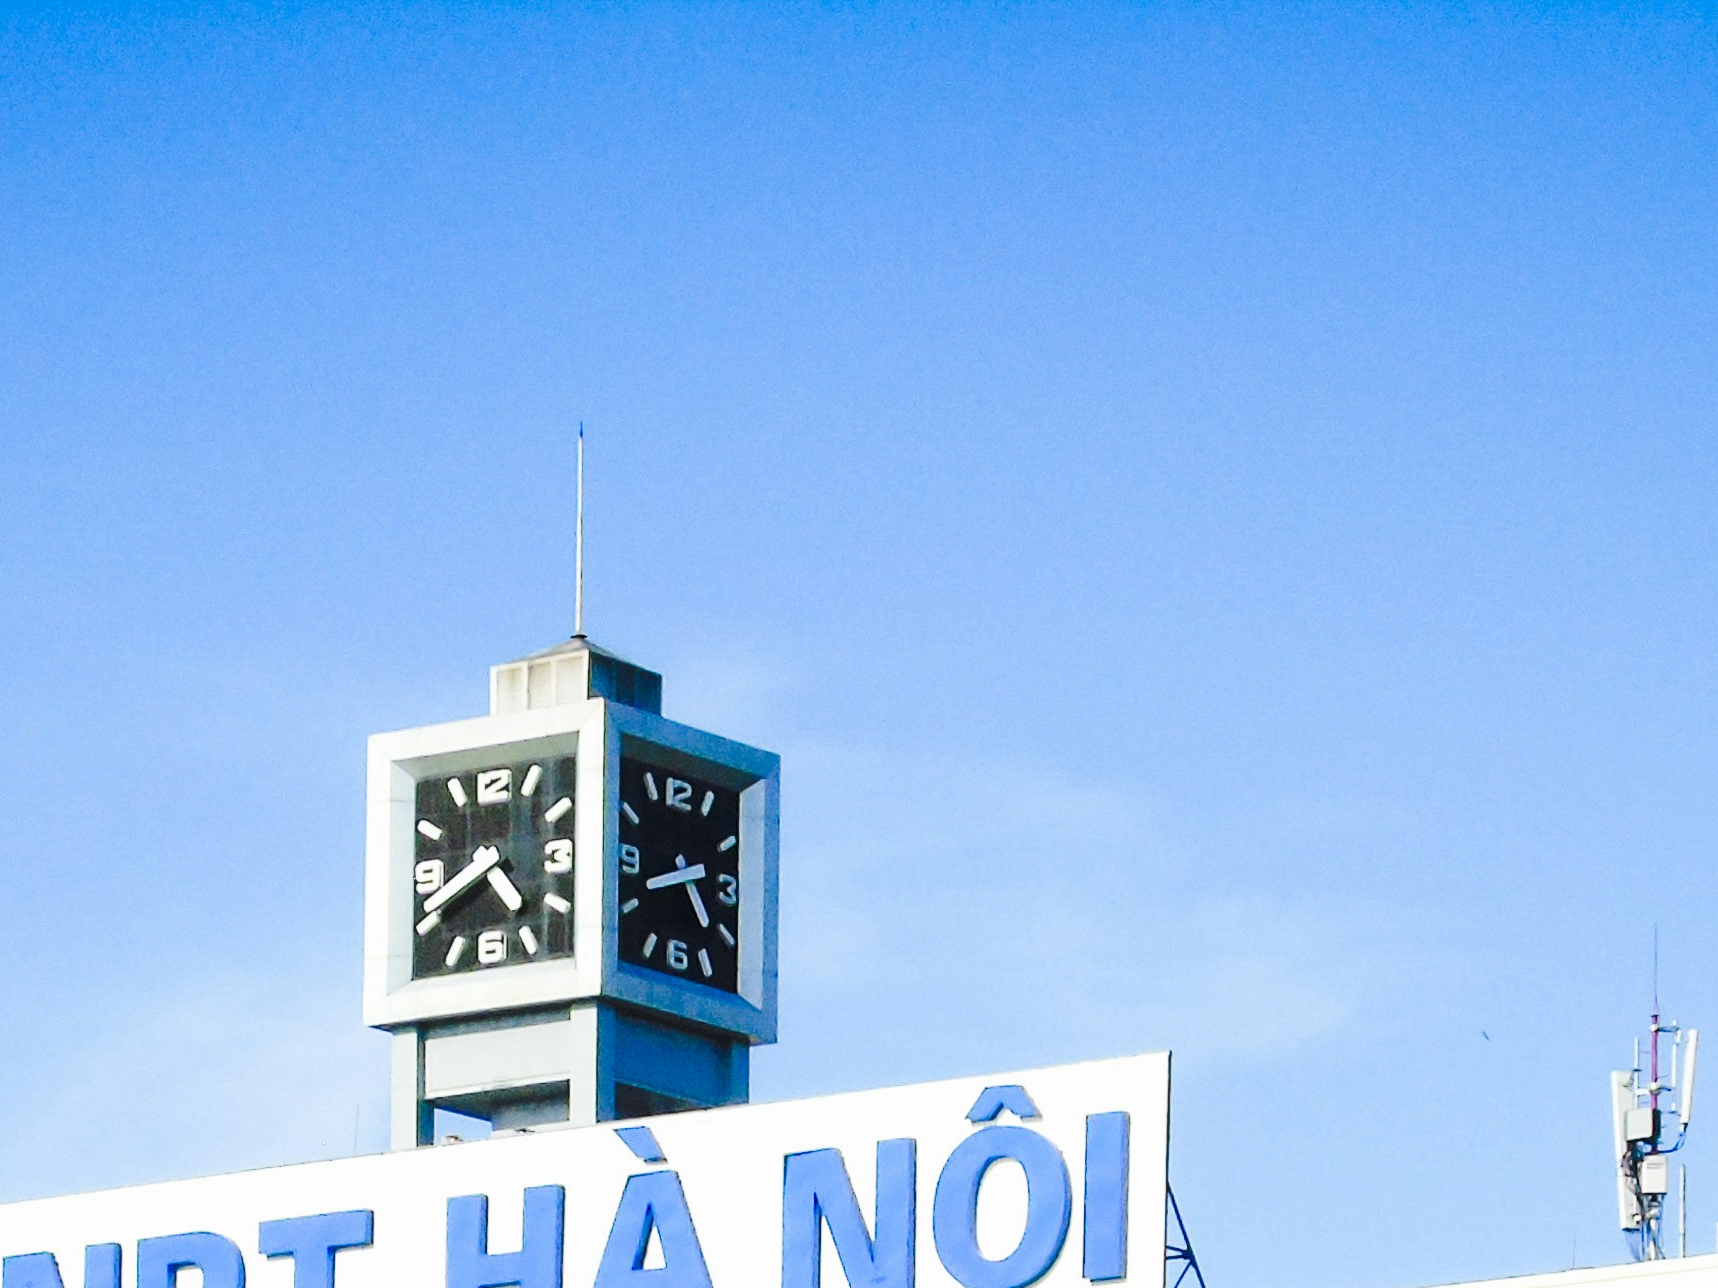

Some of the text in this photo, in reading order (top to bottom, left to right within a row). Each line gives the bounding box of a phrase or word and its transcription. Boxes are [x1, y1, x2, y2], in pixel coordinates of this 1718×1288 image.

[477, 769, 512, 804] 12
[666, 777, 693, 812] 12
[544, 839, 573, 874] 3
[620, 845, 640, 874] 9
[415, 859, 445, 895] 9
[718, 873, 738, 905] 3
[478, 930, 508, 965] 6
[667, 939, 688, 971] 6
